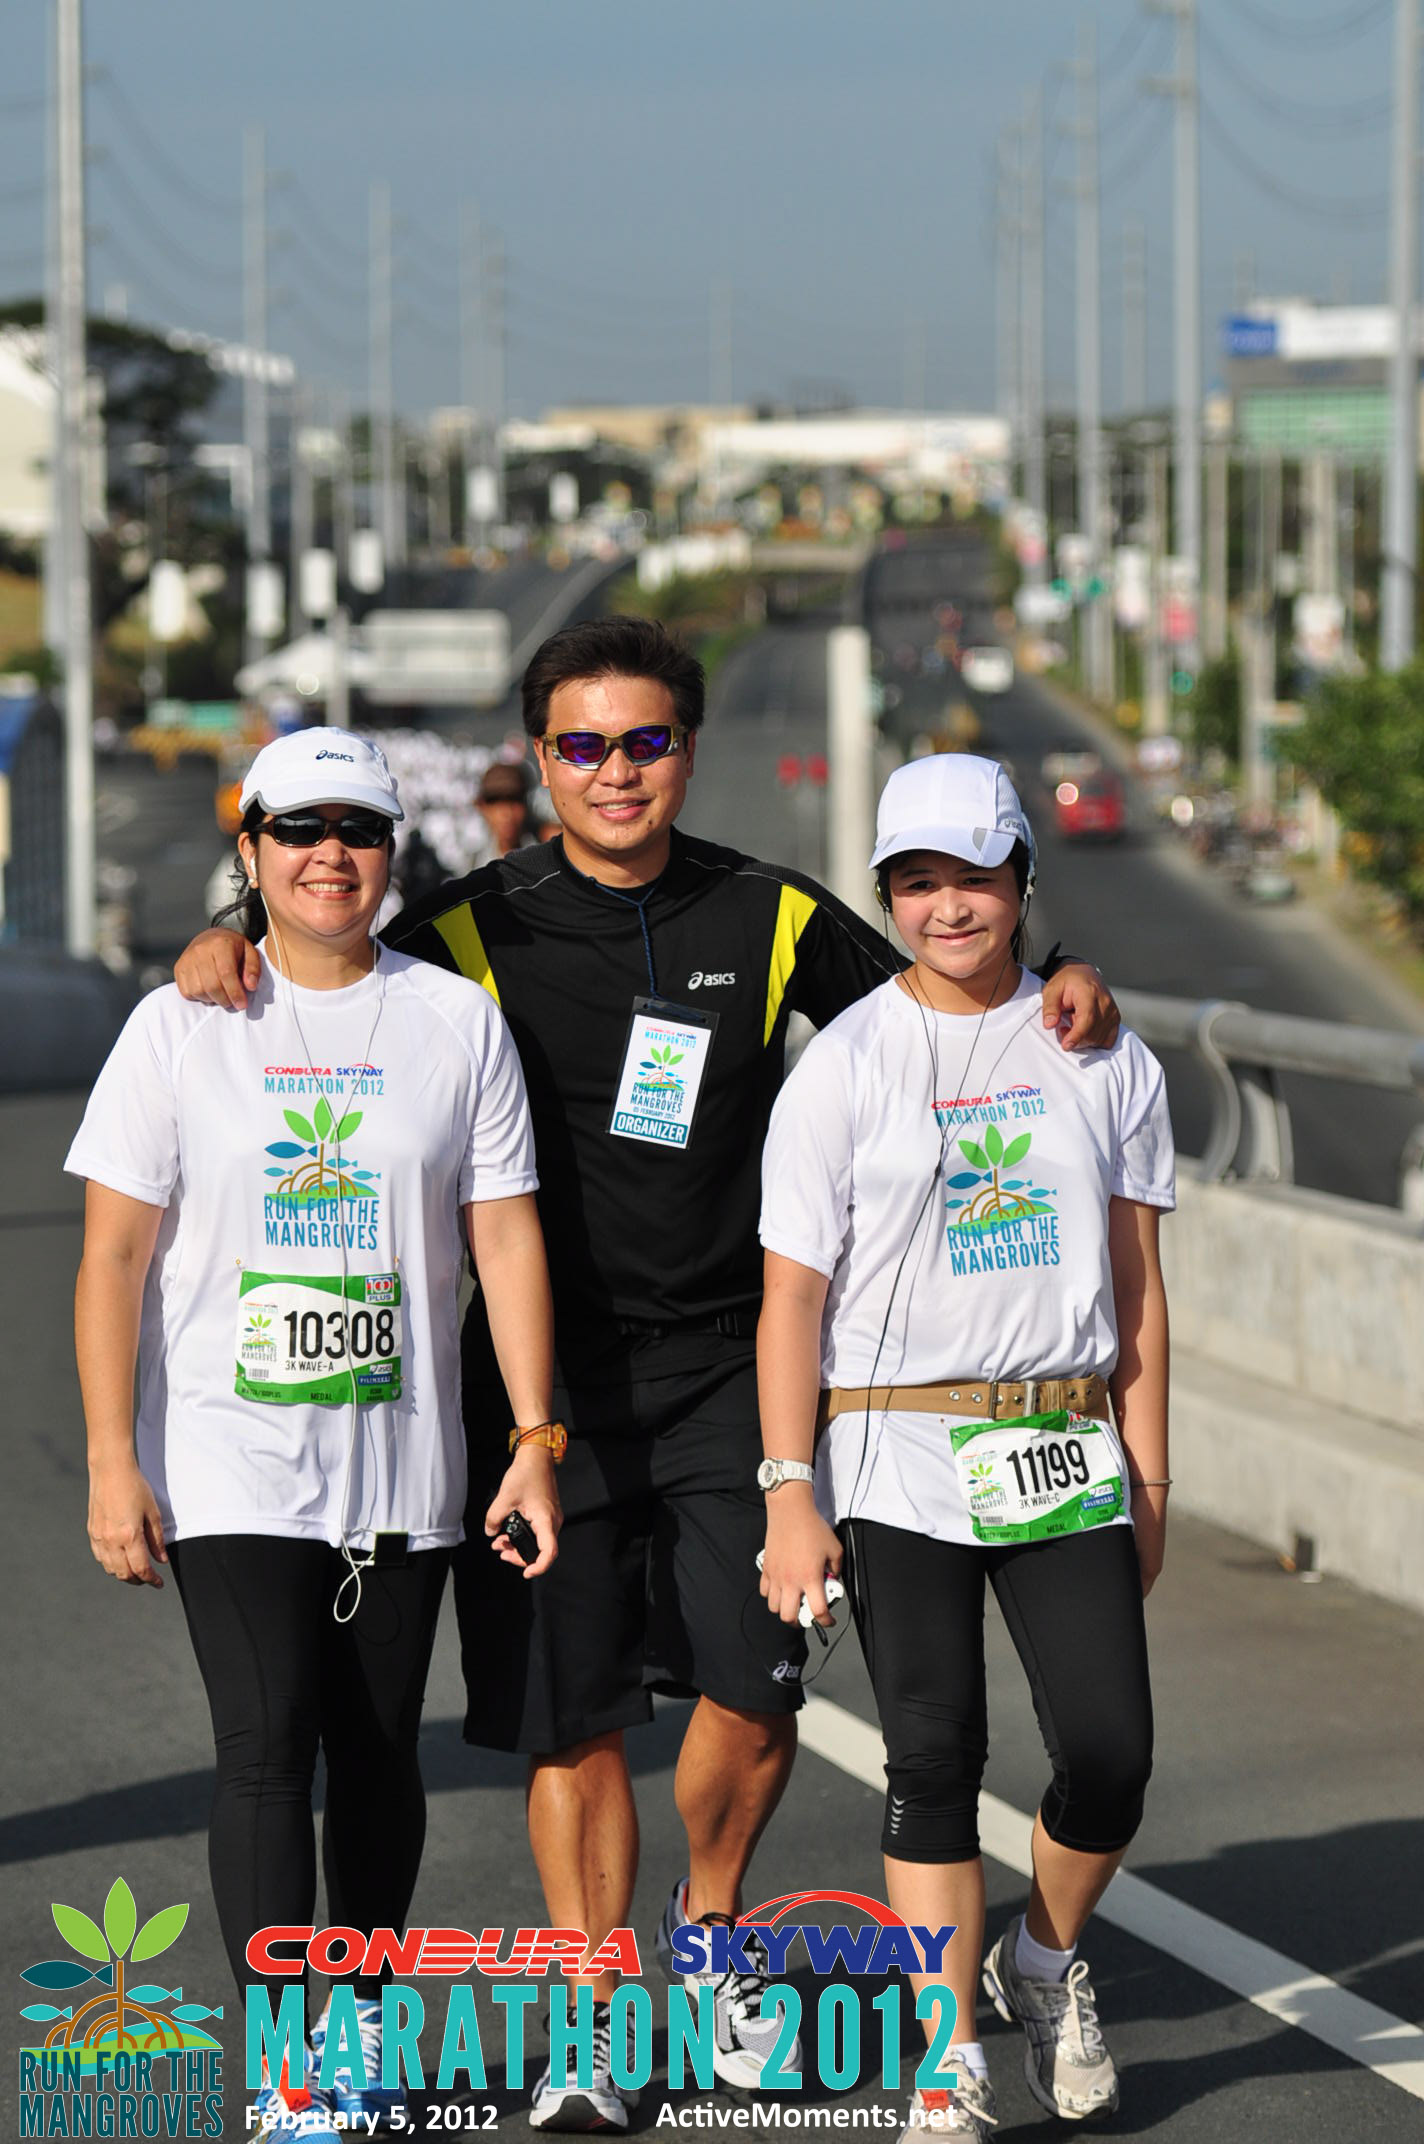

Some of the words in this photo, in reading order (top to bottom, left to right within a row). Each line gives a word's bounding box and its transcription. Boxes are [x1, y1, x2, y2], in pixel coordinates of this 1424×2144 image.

[326, 751, 355, 763] asics
[703, 972, 736, 987] asics
[264, 1077, 345, 1094] MARATHON
[351, 1078, 385, 1096] 2012
[931, 1096, 993, 1110] CONDURA
[995, 1087, 1042, 1102] SKYWAY
[630, 1093, 683, 1114] MANGROVES
[934, 1103, 1008, 1127] MARATHON
[1012, 1098, 1046, 1118] 2012
[616, 1114, 686, 1142] ORGANIZER
[264, 1196, 299, 1221] RUN
[307, 1198, 339, 1222] FOR
[346, 1199, 380, 1223] THE
[265, 1221, 378, 1250] MANGROVES
[946, 1223, 985, 1251] RUN
[990, 1220, 1024, 1245] FOR
[1028, 1216, 1060, 1241] THE
[950, 1240, 1061, 1277] MANGROVES
[367, 1279, 392, 1294] 100
[284, 1308, 395, 1360] 10308
[285, 1360, 297, 1371] 3K
[299, 1361, 334, 1372] WAVE-A
[1006, 1439, 1090, 1496] 11199
[1019, 1498, 1031, 1510] 3K
[1031, 1492, 1061, 1506] WAVE-C
